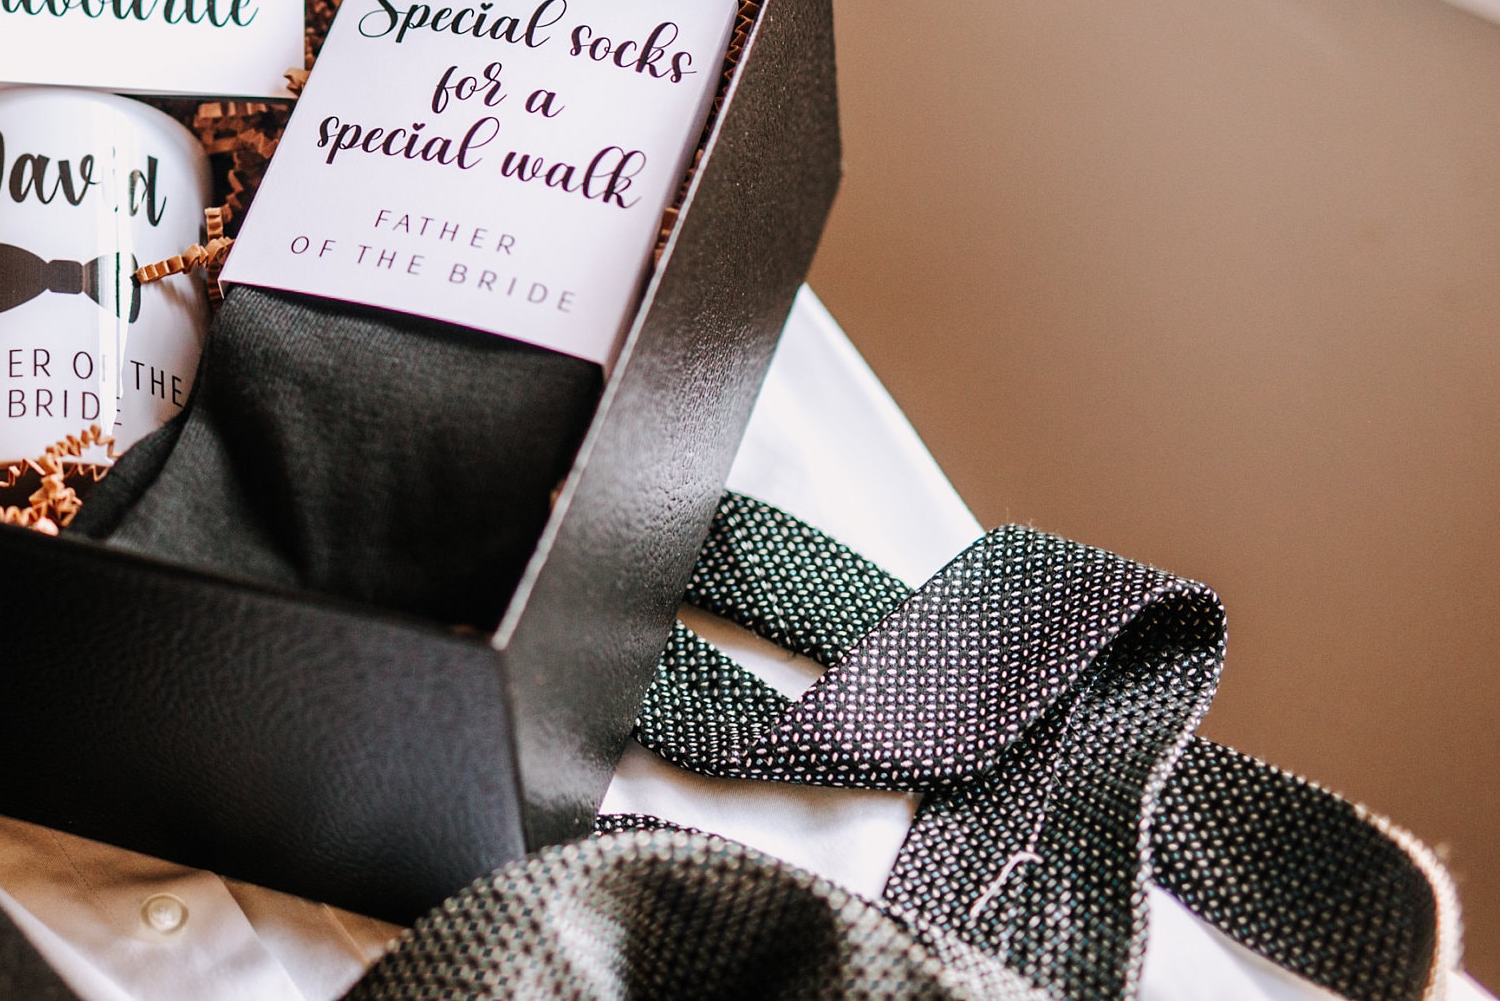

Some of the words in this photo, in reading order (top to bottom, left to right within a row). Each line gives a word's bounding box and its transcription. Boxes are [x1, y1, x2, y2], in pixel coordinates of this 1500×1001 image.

[570, 22, 698, 84] socks
[431, 62, 508, 114] for
[525, 88, 566, 118] a
[316, 116, 501, 170] special
[501, 145, 647, 209] walk
[374, 209, 517, 256] FATHER
[290, 235, 337, 259] OF
[356, 244, 426, 276] THE
[448, 262, 576, 314] BRIDE
[129, 359, 185, 409] THE
